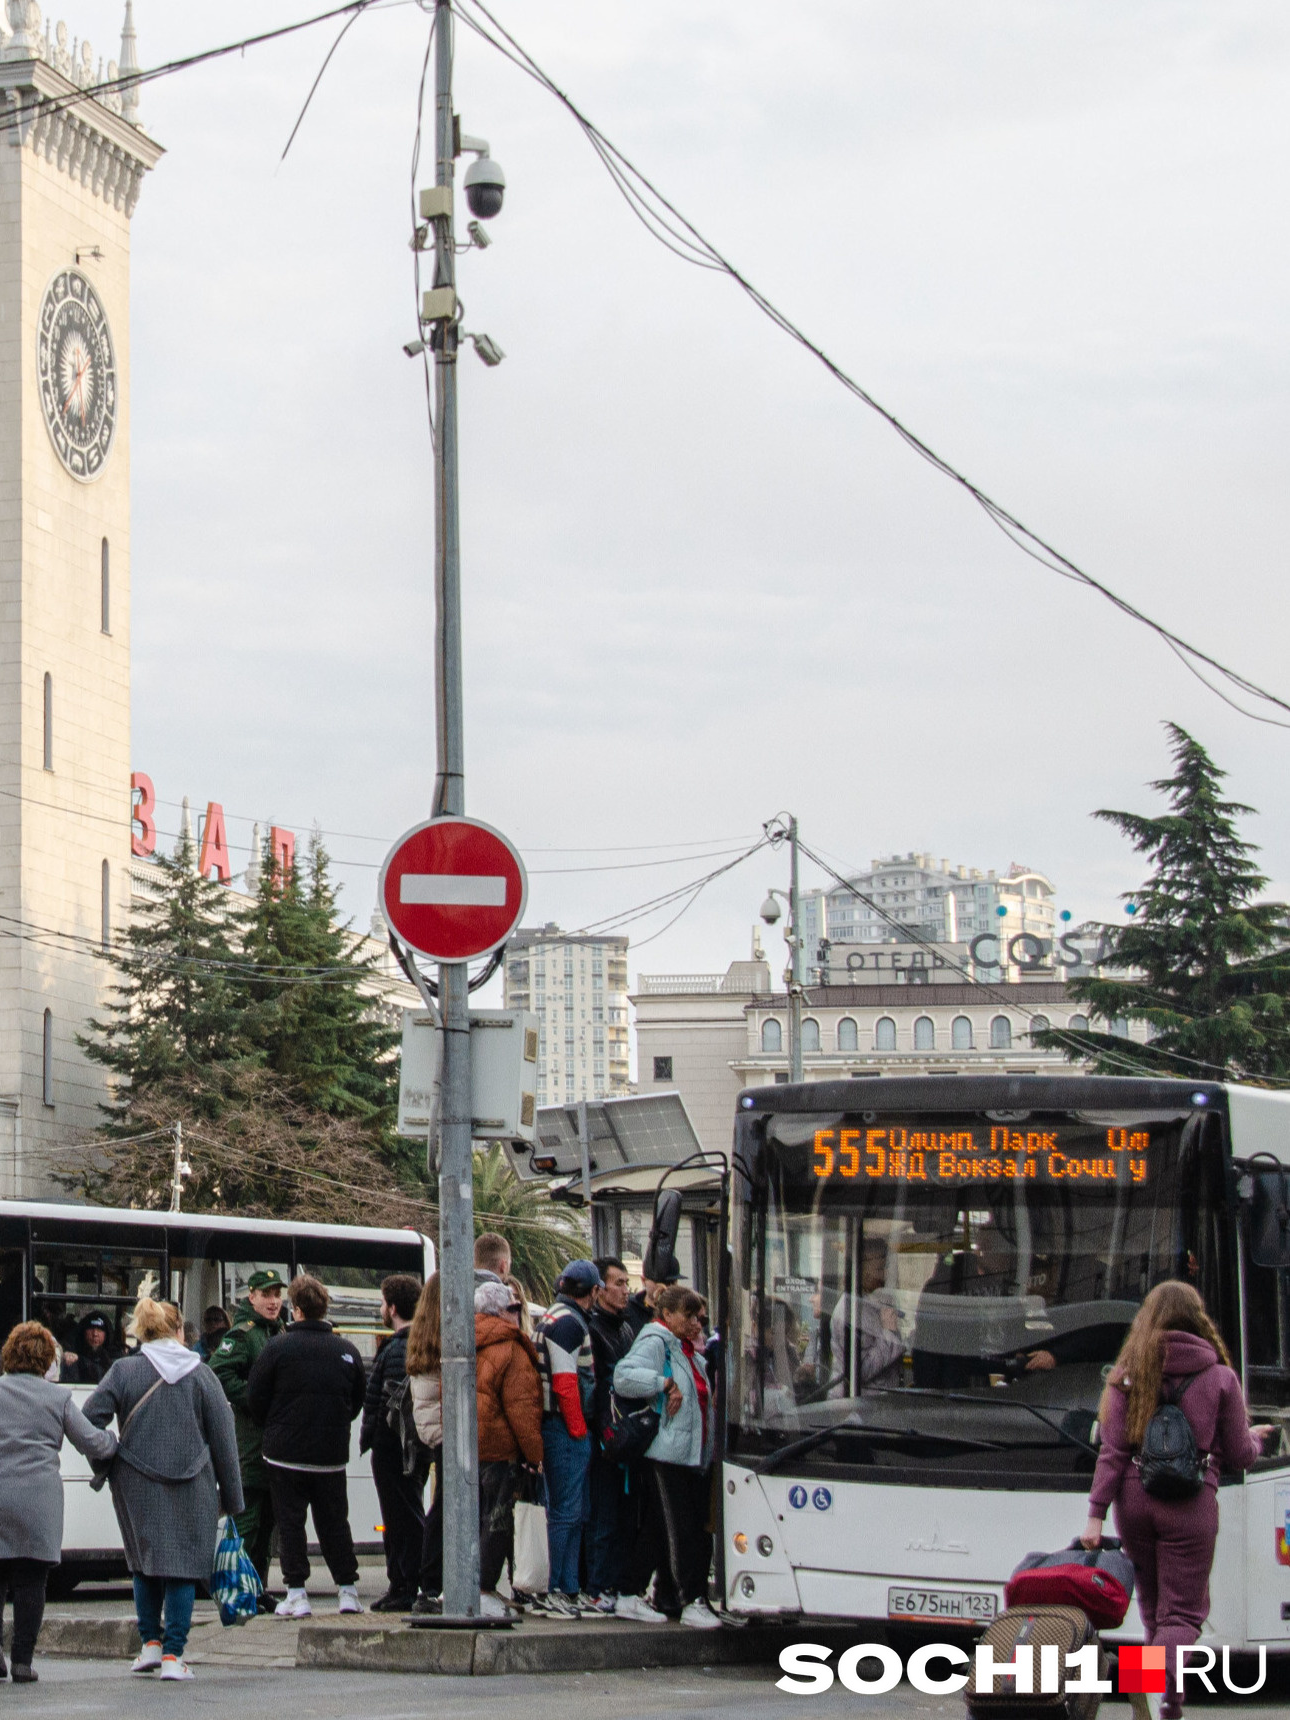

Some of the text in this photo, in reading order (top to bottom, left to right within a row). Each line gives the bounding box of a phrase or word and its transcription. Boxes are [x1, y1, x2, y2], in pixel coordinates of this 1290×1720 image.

[846, 951, 946, 971] ОТЕЛЬ
[813, 1128, 886, 1177] 555
[991, 1126, 1057, 1154] Парк
[888, 1152, 927, 1180] ЖД
[939, 1152, 1036, 1178] Вокзал
[1048, 1152, 1117, 1178] Сочи
[965, 1596, 989, 1611] 123
